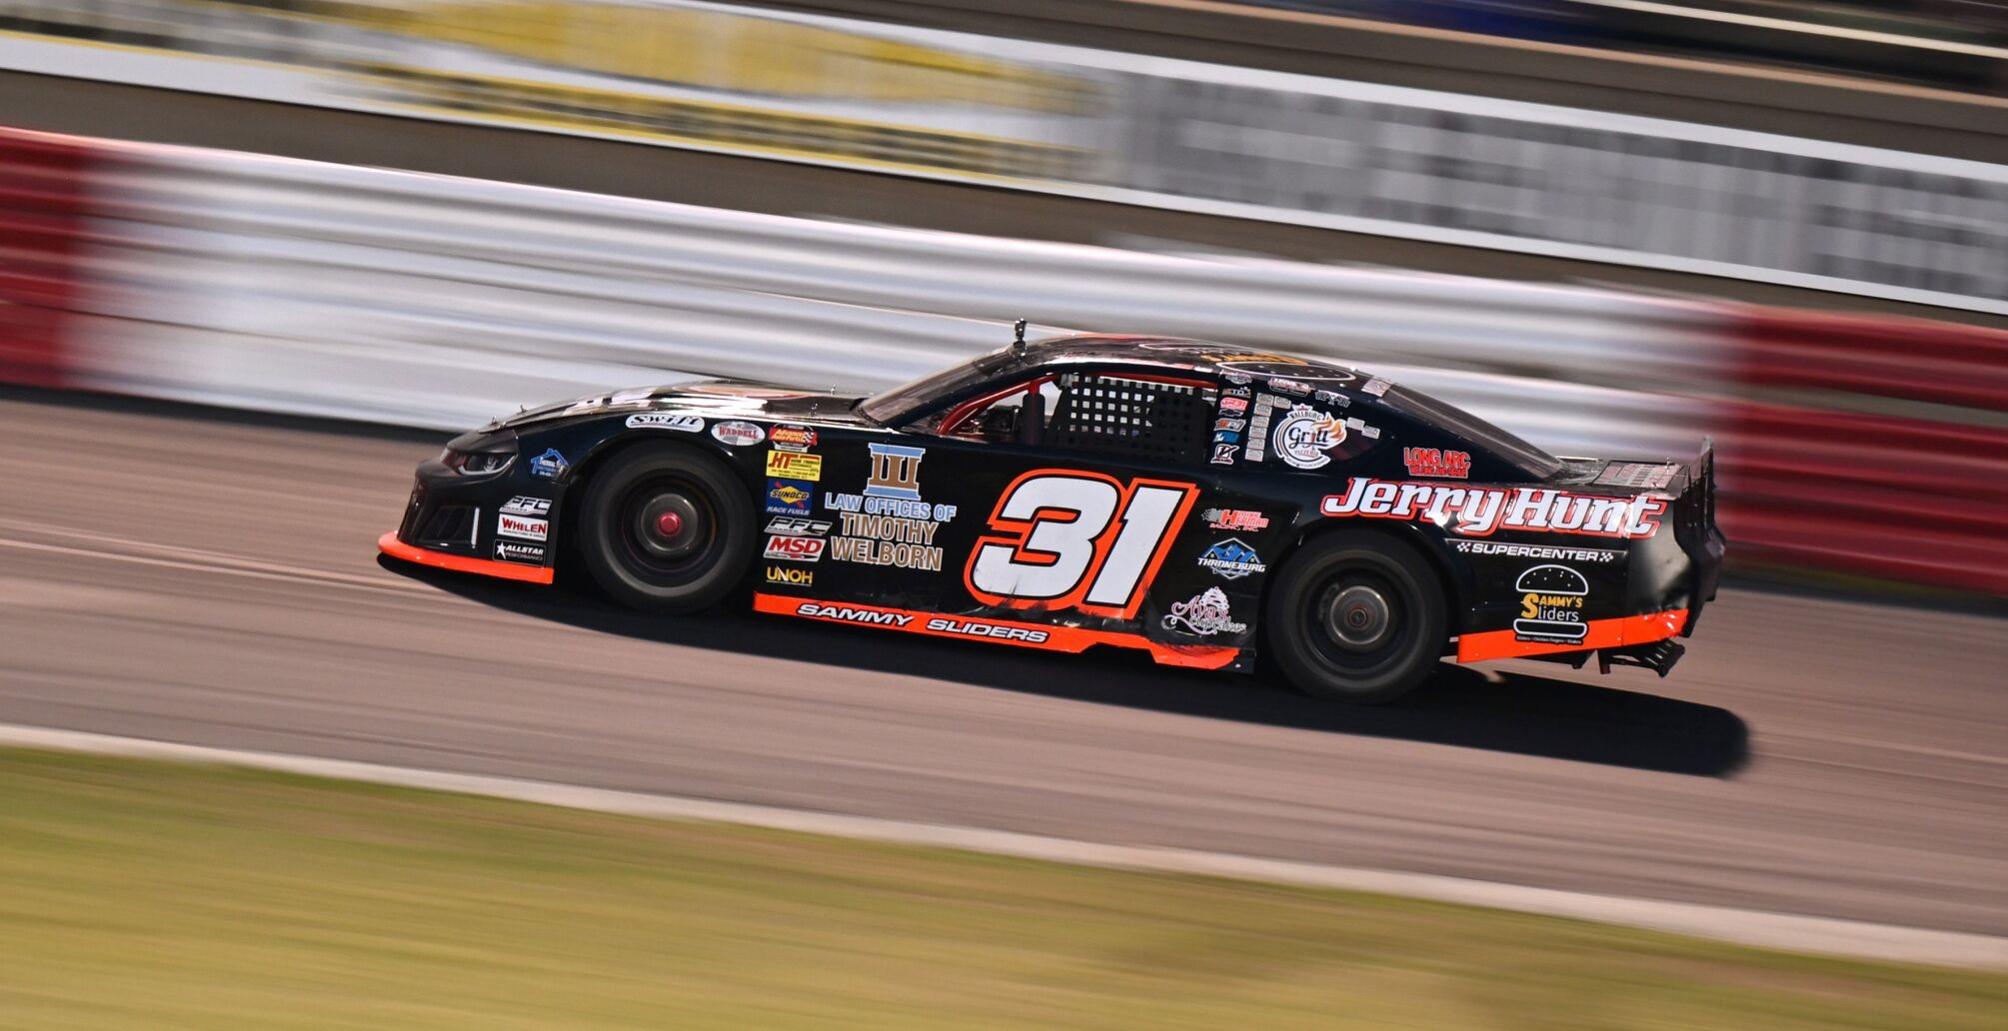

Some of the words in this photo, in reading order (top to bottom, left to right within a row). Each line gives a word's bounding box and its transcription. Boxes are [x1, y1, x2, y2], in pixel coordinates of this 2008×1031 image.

[719, 426, 759, 440] WADDELL
[1403, 447, 1441, 466] LONG
[770, 488, 810, 500] SUNOCO
[824, 492, 863, 512] LAW
[865, 497, 931, 519] OFFICES
[933, 504, 957, 522] OF
[840, 511, 939, 545] TIMOTHY
[505, 544, 544, 555] ALLSTAR
[769, 537, 823, 554] MSD
[967, 470, 1195, 612] 31
[831, 536, 943, 571] WELBORN
[1472, 543, 1598, 562] SUPERCENTER
[1197, 557, 1266, 573] THRONEBURG
[767, 566, 813, 584] UNOH
[797, 603, 915, 627] SAMMY
[926, 618, 1048, 643] SLIDERS
